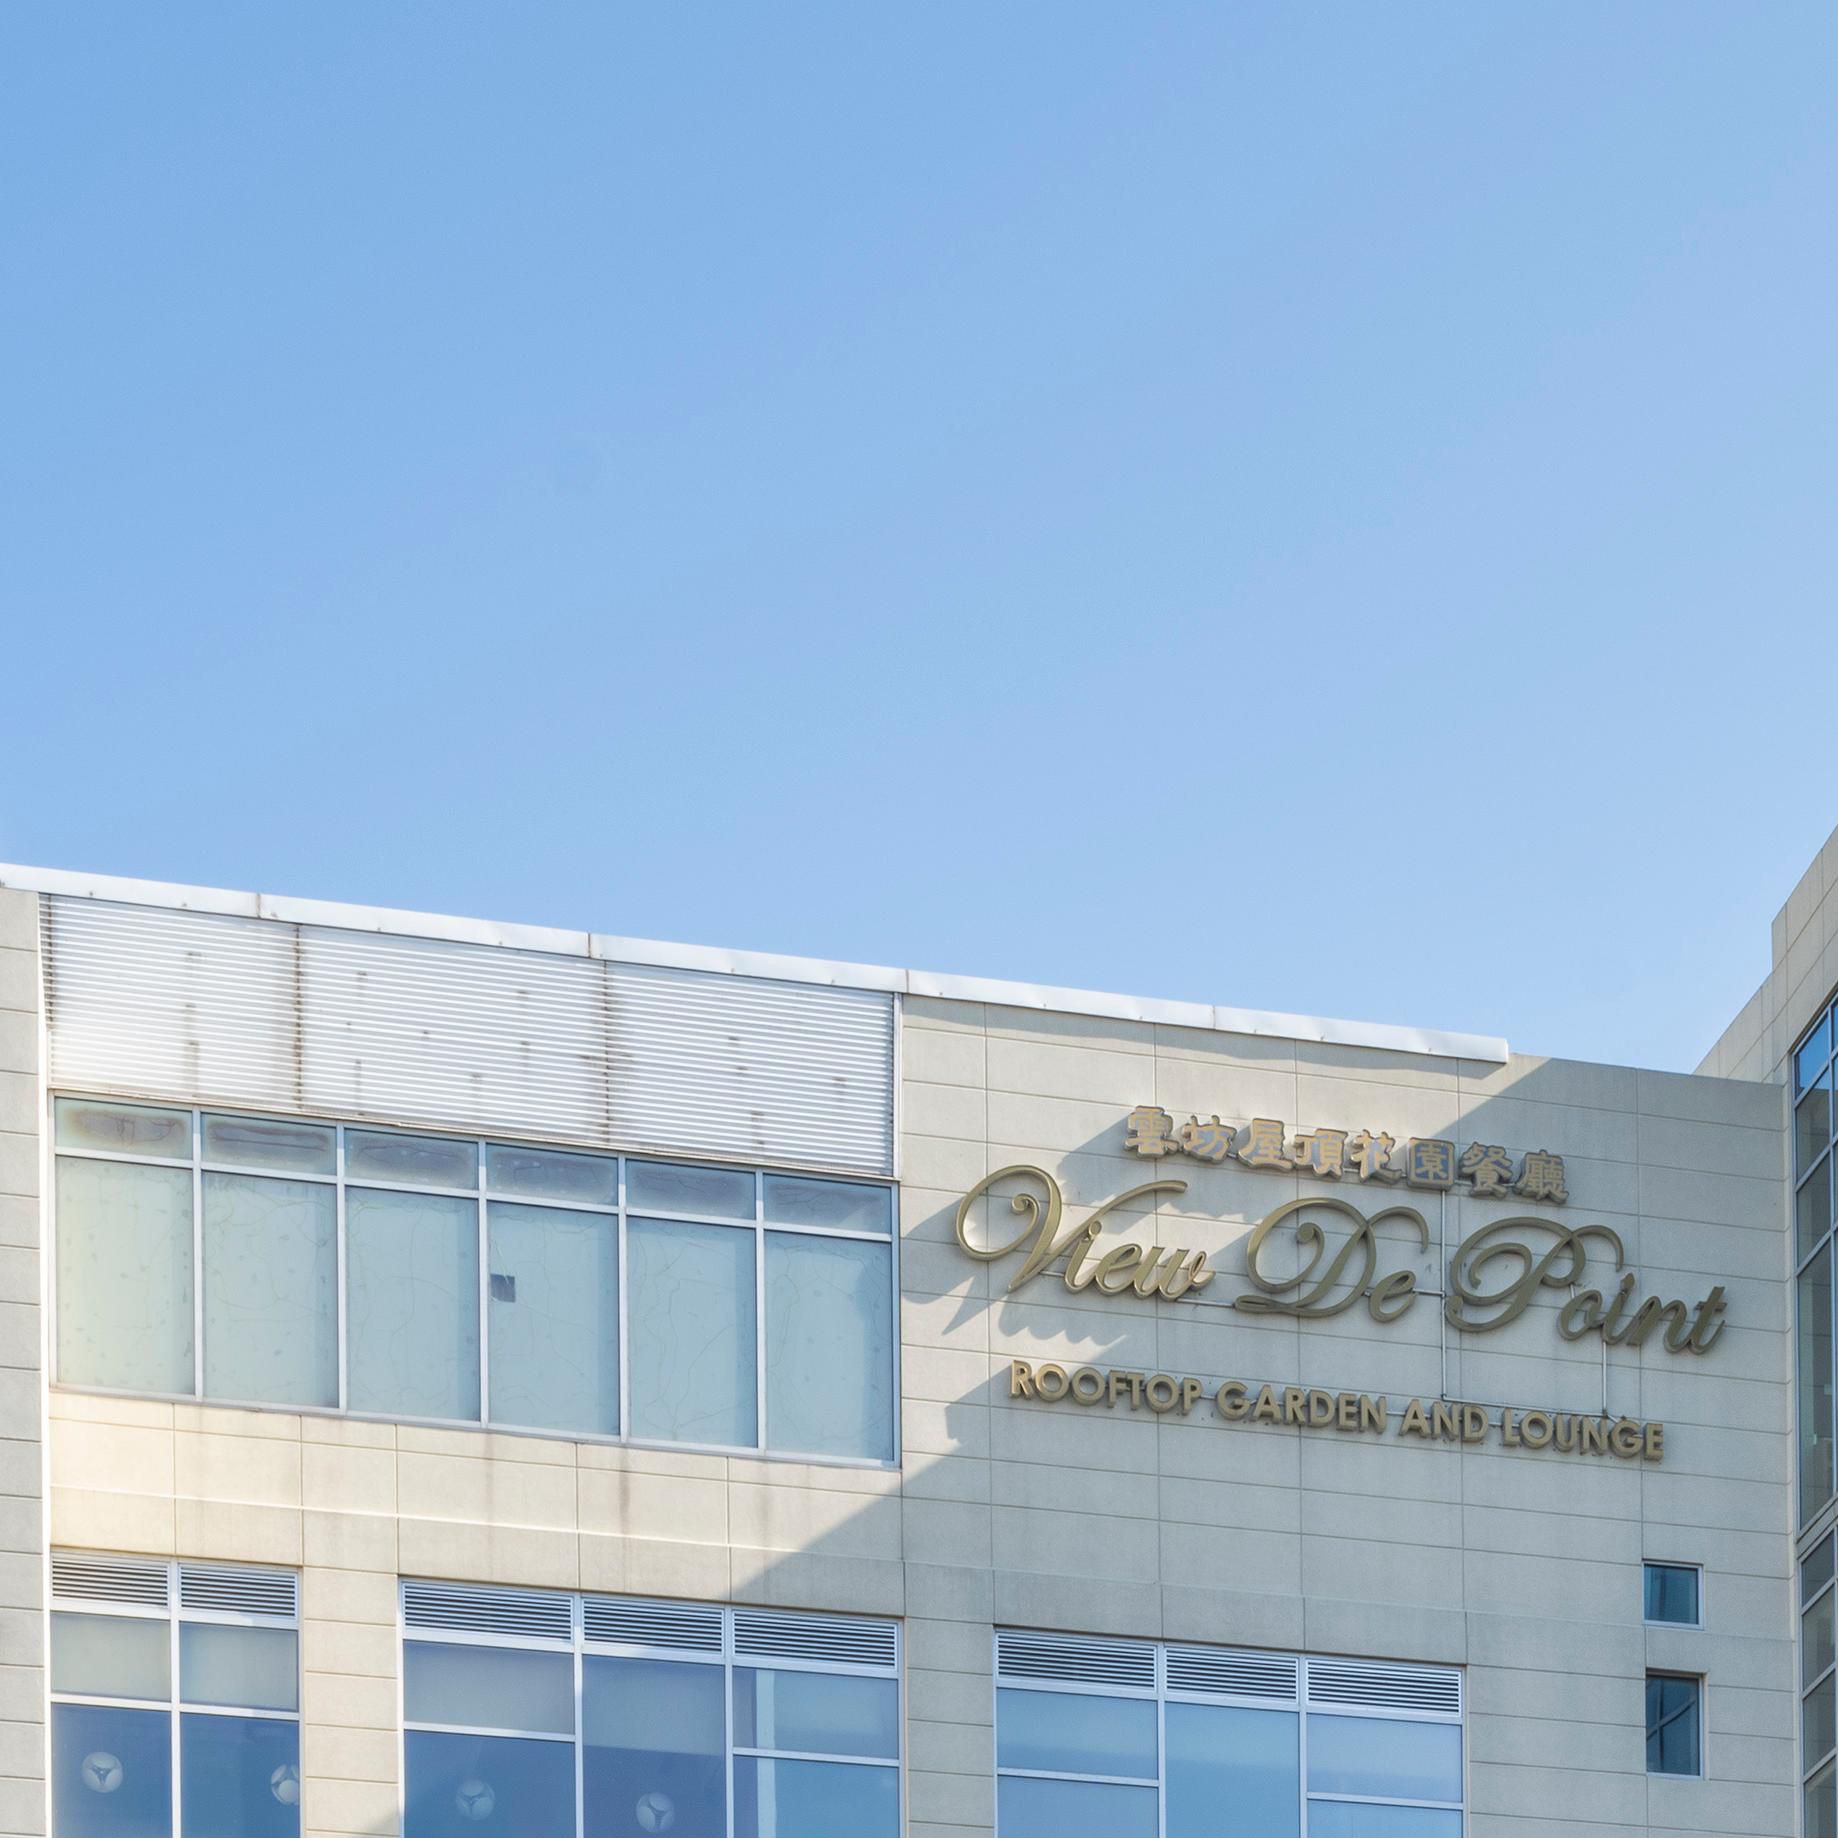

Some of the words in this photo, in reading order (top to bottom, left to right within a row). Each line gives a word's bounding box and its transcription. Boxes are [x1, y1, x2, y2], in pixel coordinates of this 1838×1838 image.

[1125, 1105, 1569, 1204] 雲坊屋頂花園餐廳
[956, 1165, 1214, 1301] View
[1233, 1196, 1429, 1323] De
[1444, 1216, 1730, 1355] Point
[1010, 1359, 1202, 1414] ROOFTOP
[1216, 1380, 1388, 1435] GARDEN
[1399, 1400, 1489, 1444] AND
[1502, 1409, 1664, 1461] LOUNGE
